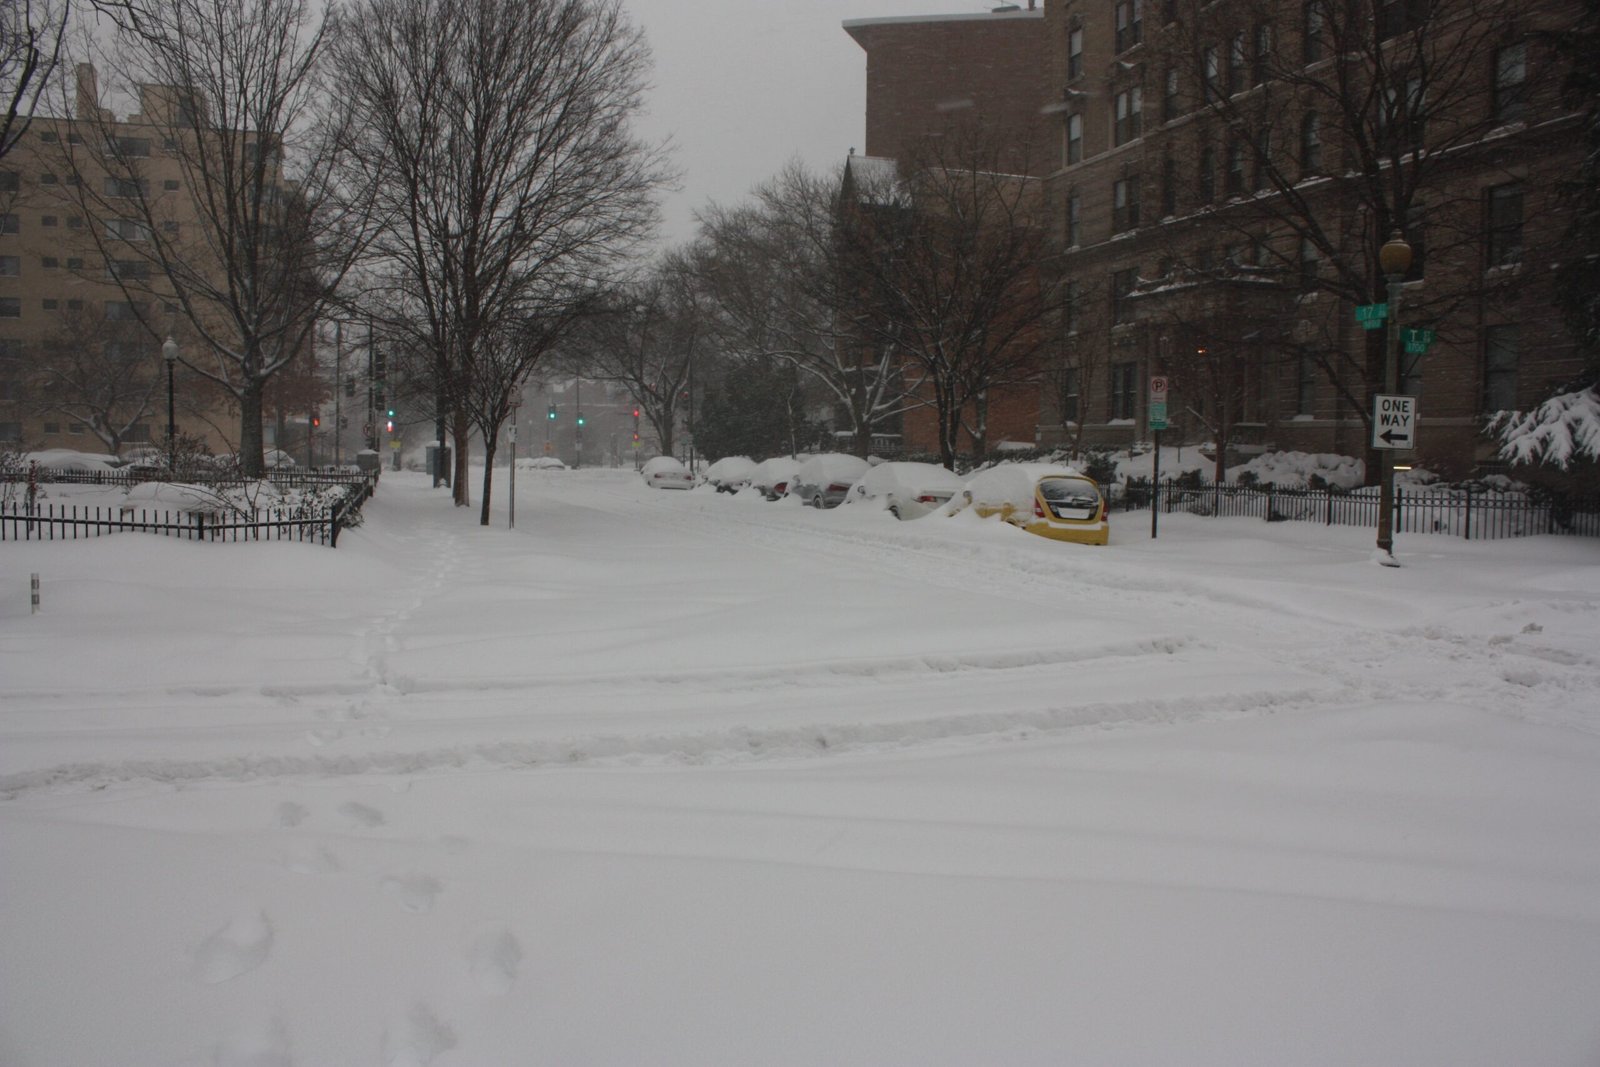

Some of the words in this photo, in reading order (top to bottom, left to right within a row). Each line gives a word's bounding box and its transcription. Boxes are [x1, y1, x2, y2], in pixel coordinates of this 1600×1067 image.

[1361, 306, 1374, 318] 17
[1410, 329, 1418, 342] T
[1382, 399, 1409, 412] ONE
[1380, 414, 1410, 427] WAY
